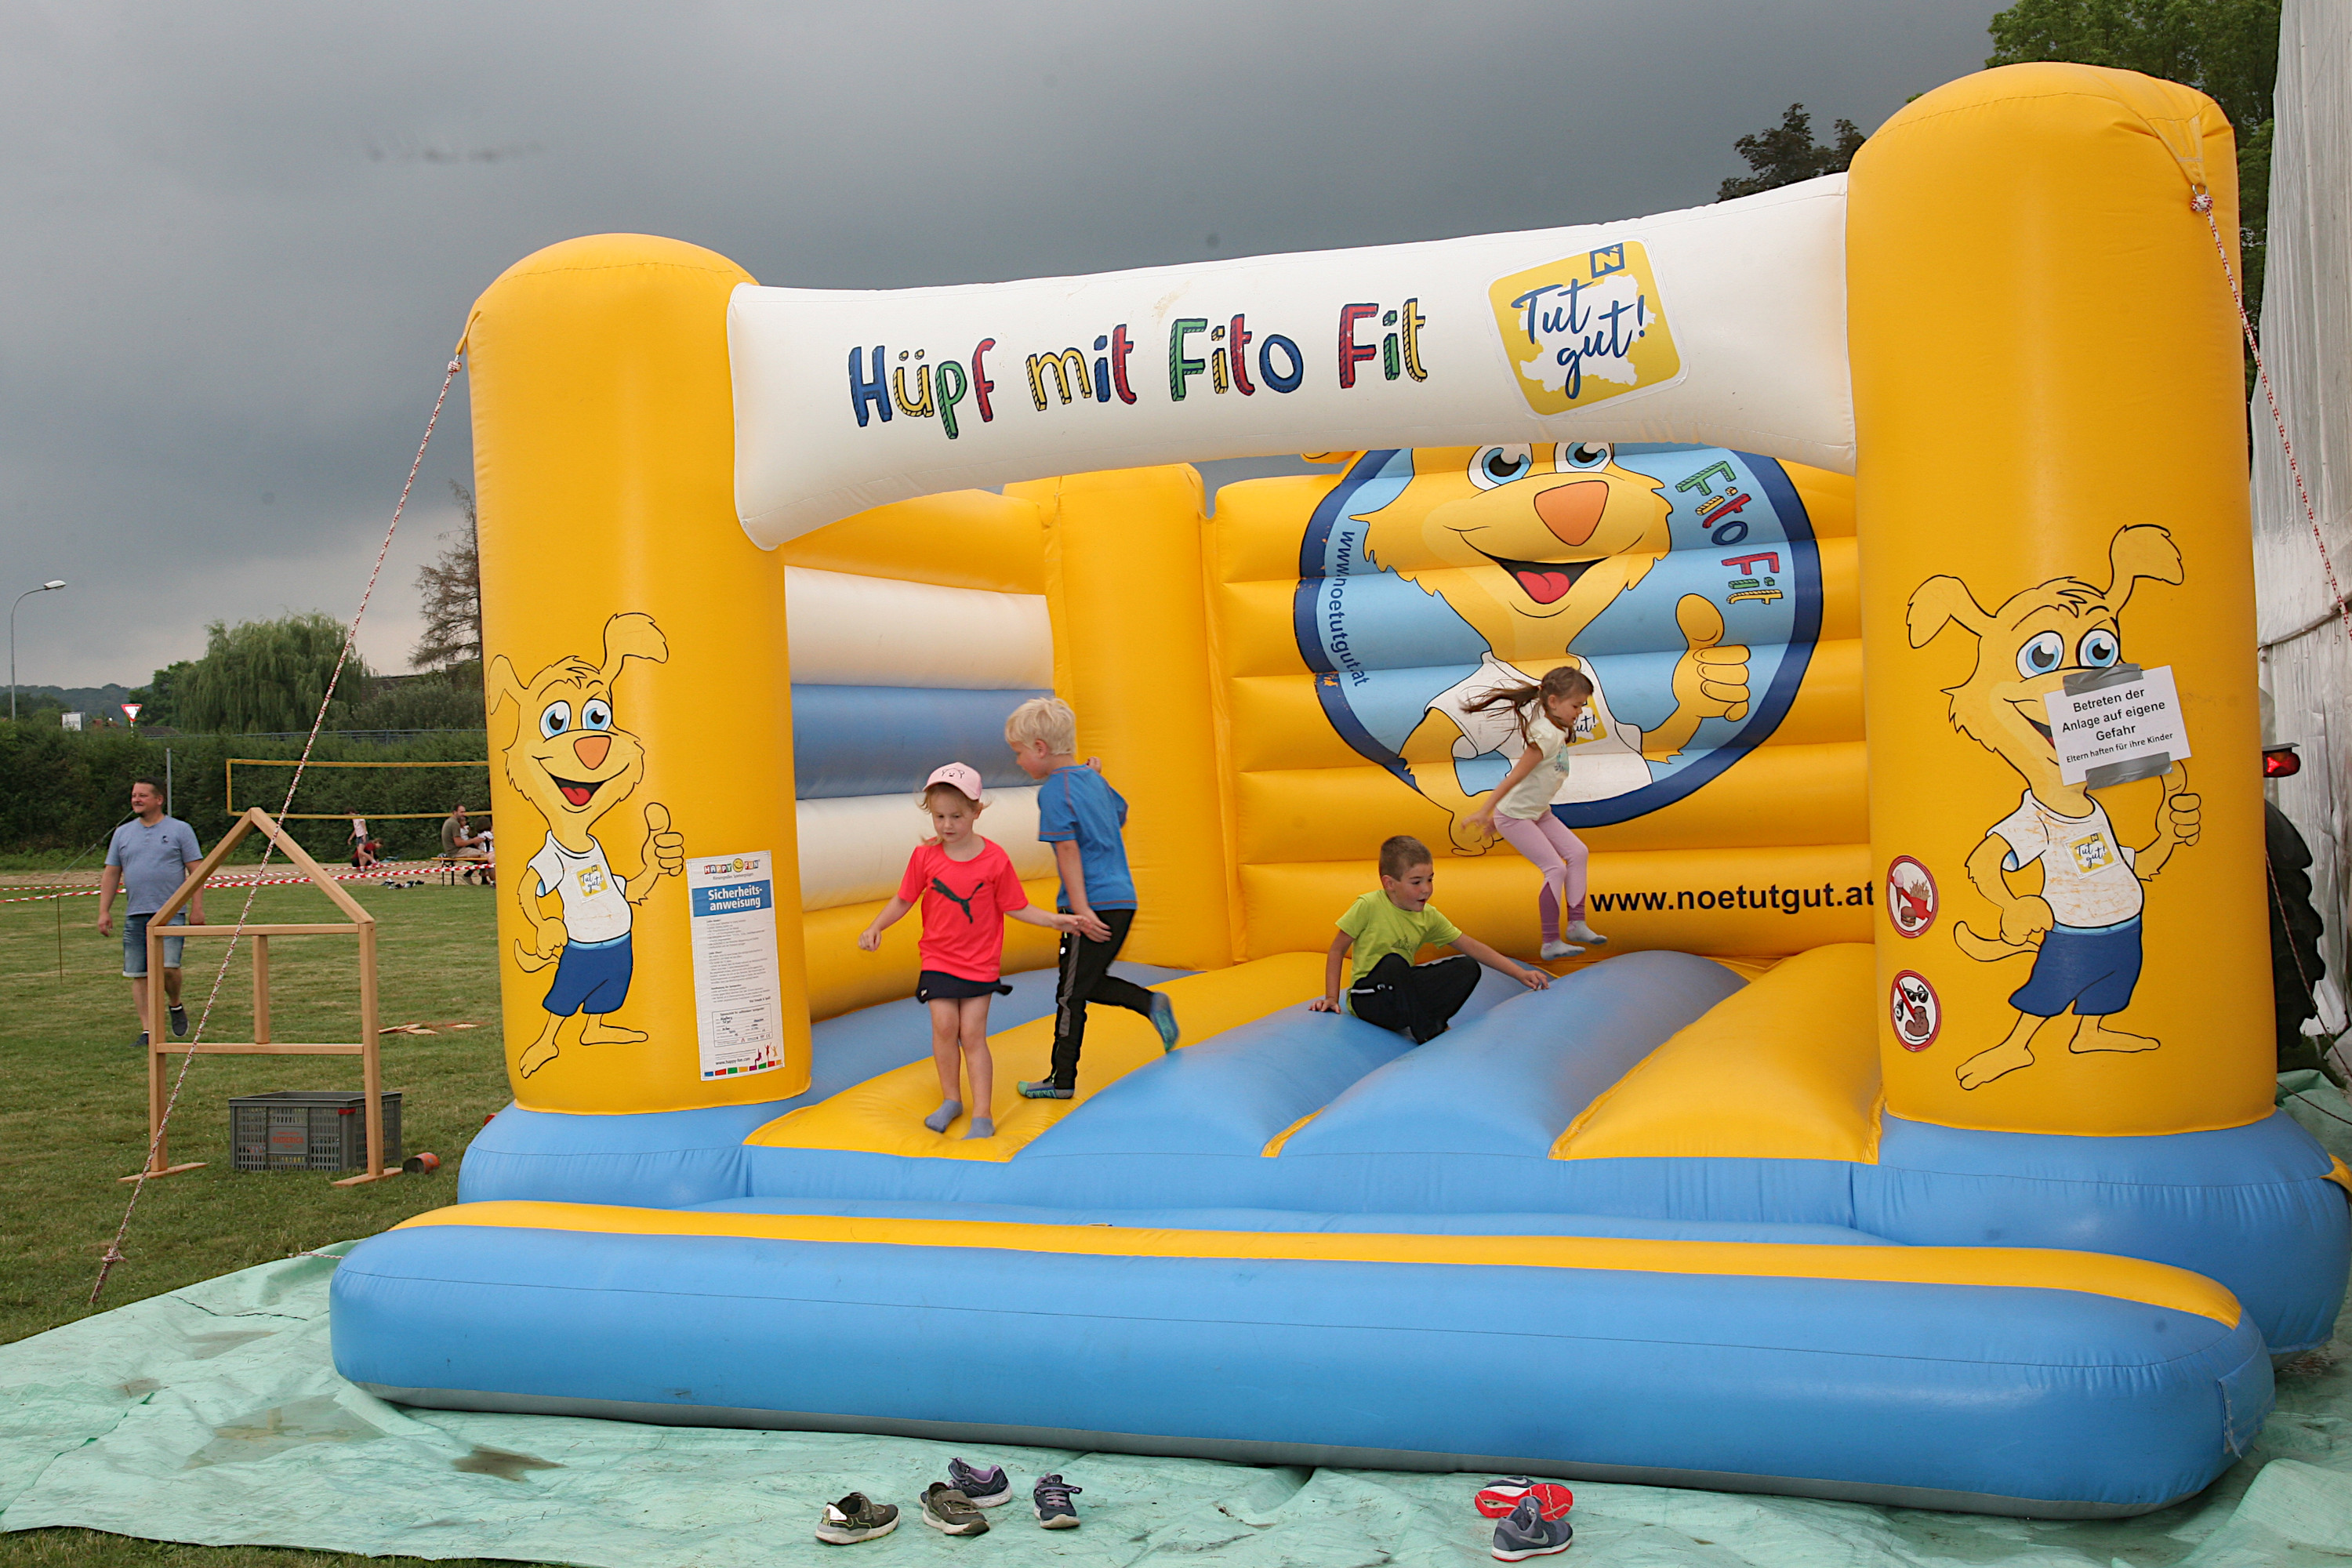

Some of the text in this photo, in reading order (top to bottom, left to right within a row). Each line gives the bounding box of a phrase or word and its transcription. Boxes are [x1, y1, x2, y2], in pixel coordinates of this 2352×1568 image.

[1511, 278, 1594, 345] Tut
[1557, 295, 1646, 400] gut!
[848, 298, 1428, 439] Hüpf mit Fito Fit
[1675, 460, 1784, 604] Fito Fit
[1329, 531, 1370, 687] www.noetutgut.at
[2073, 688, 2145, 713] Betreten der
[2062, 701, 2166, 733] Anlage auf eigene
[2096, 724, 2136, 741] Gefahr
[2067, 731, 2173, 764] Eltern haften für ihre Kinder
[2074, 842, 2094, 857] Tut
[2085, 845, 2107, 869] gut!
[580, 872, 593, 884] Tut
[703, 859, 759, 874] HAPPY FUN
[587, 874, 603, 894] gut!
[708, 884, 763, 901] Sicherheits-
[710, 897, 761, 911] anweisung
[1590, 880, 1874, 914] www.noetutgut.at
